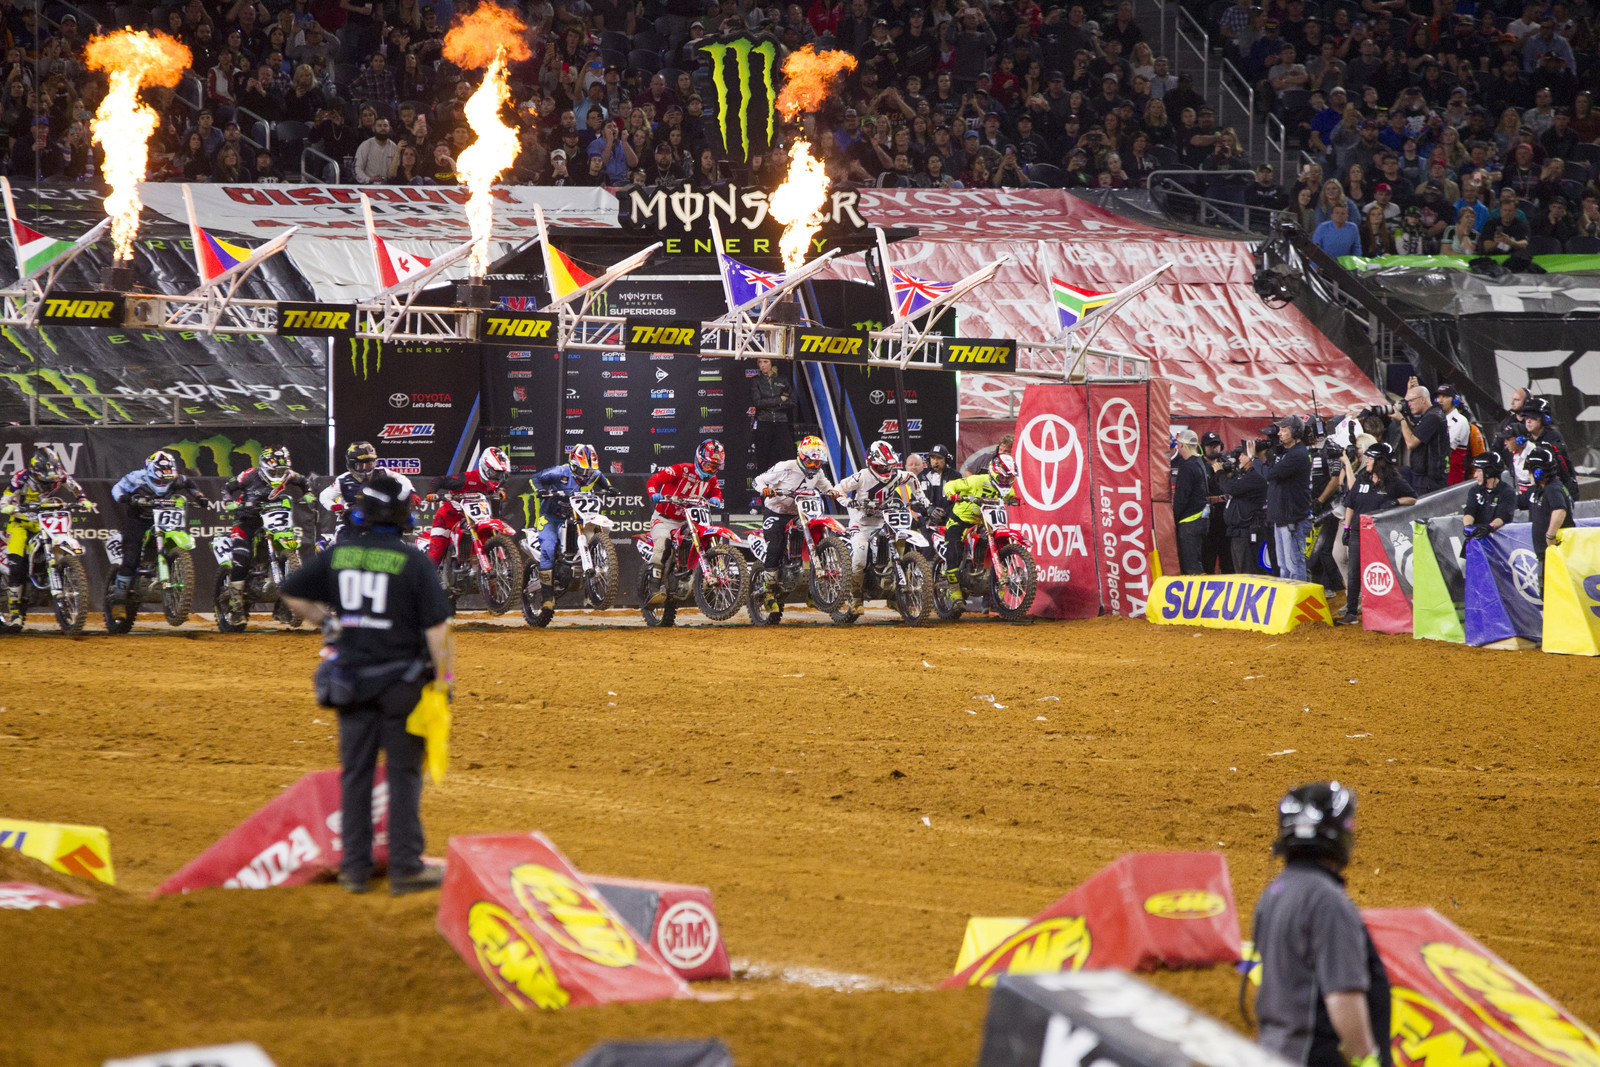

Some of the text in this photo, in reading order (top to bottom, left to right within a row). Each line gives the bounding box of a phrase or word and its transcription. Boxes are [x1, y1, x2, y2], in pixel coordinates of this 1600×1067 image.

[629, 183, 866, 231] MONSR
[911, 207, 956, 216] Go
[959, 207, 1061, 217] Places
[666, 239, 828, 253] ENERY
[974, 245, 1057, 267] Lets
[1064, 246, 1117, 267] Go
[619, 292, 663, 301] MONSTER
[45, 299, 115, 319] THOR
[283, 310, 350, 330] THOR
[486, 318, 552, 338] THOR
[631, 326, 695, 346] THOR
[800, 335, 863, 355] THOR
[948, 345, 1010, 364] THOR
[411, 393, 452, 402] TOYOTA
[886, 390, 917, 398] TOOTA
[381, 424, 434, 437] AMSOIL
[882, 420, 921, 431] AMOIL
[376, 459, 420, 467] ARTS
[575, 499, 599, 514] 22
[1100, 485, 1115, 528] Let's
[46, 517, 68, 534] 21
[158, 510, 183, 526] 69
[267, 511, 289, 531] 3
[888, 513, 911, 526] 59
[1103, 532, 1117, 557] Go
[1118, 480, 1149, 618] TOYOTA
[1047, 565, 1070, 582] Places
[338, 569, 389, 614] 04
[1162, 580, 1277, 626] SUZUKI
[223, 825, 320, 889] NDA
